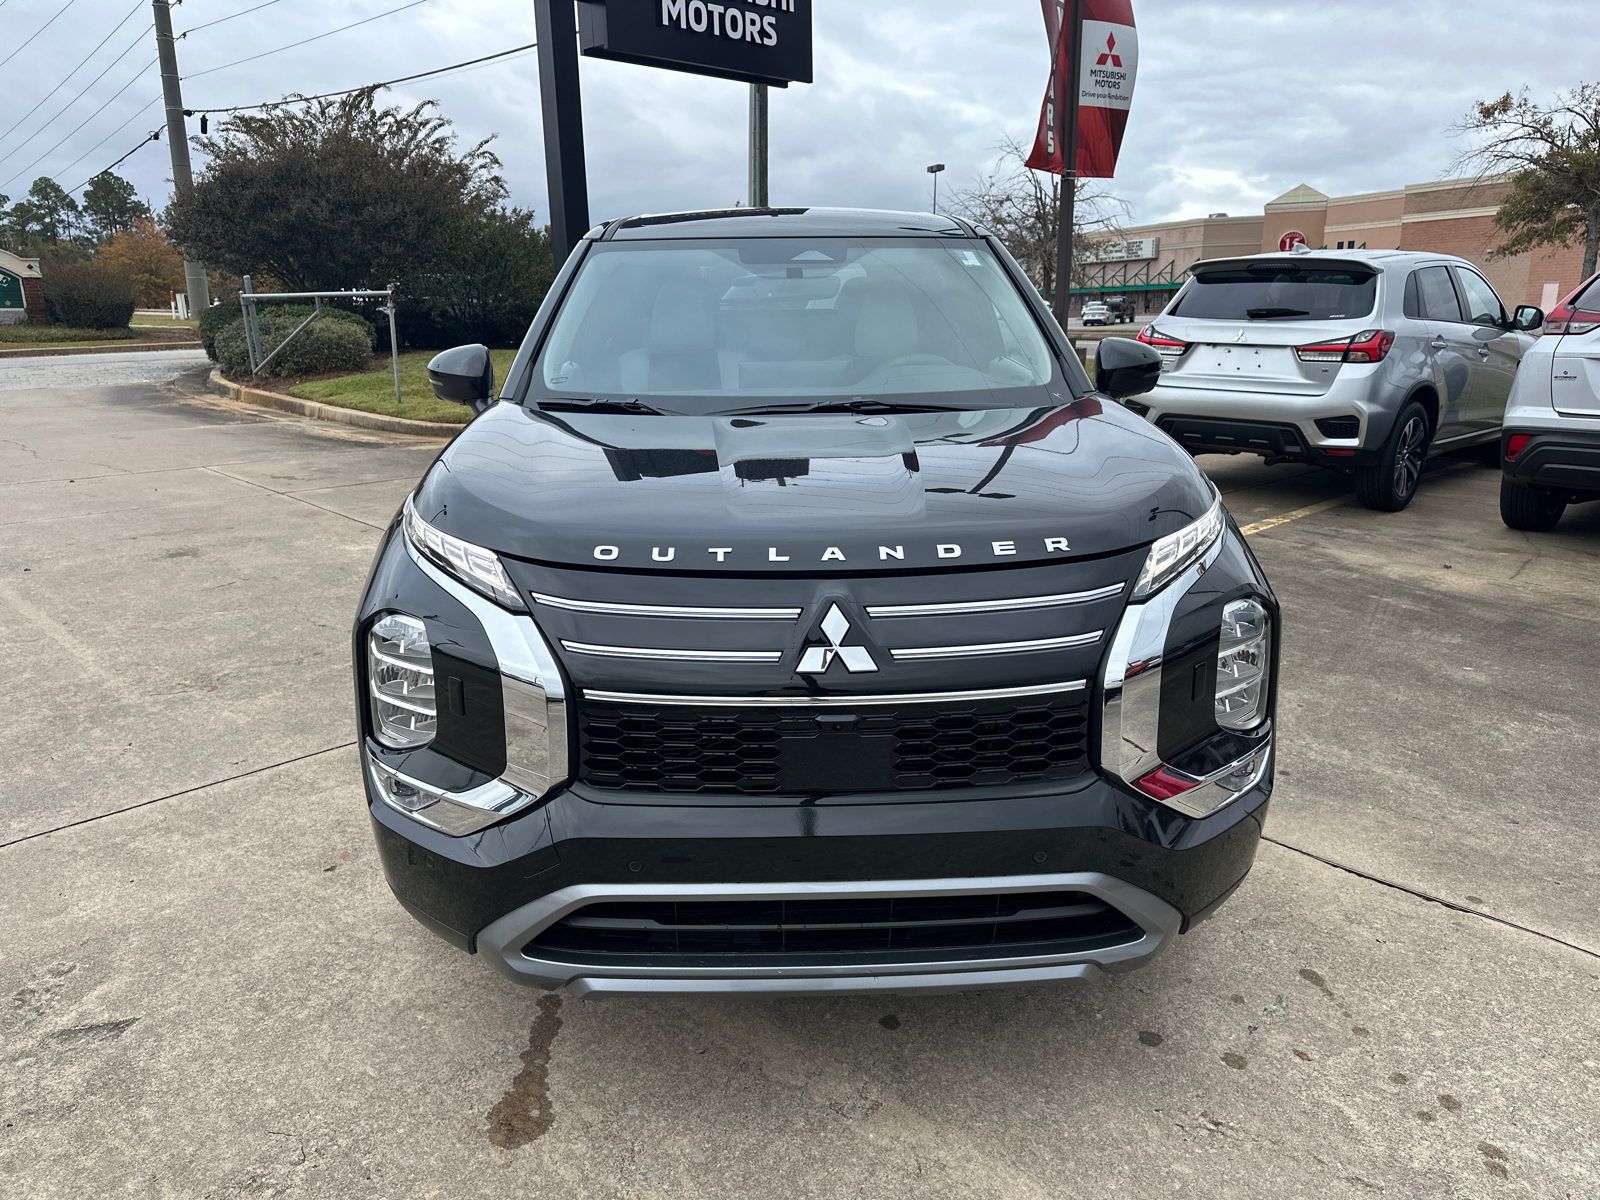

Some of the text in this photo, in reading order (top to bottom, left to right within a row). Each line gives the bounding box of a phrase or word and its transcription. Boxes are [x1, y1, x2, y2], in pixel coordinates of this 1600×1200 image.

[661, 0, 778, 46] MOTORS
[1090, 69, 1127, 80] MITSUBISHI
[1094, 79, 1121, 89] MOTORS
[1081, 90, 1096, 98] Drive
[593, 537, 1071, 562] OUTLANDER
